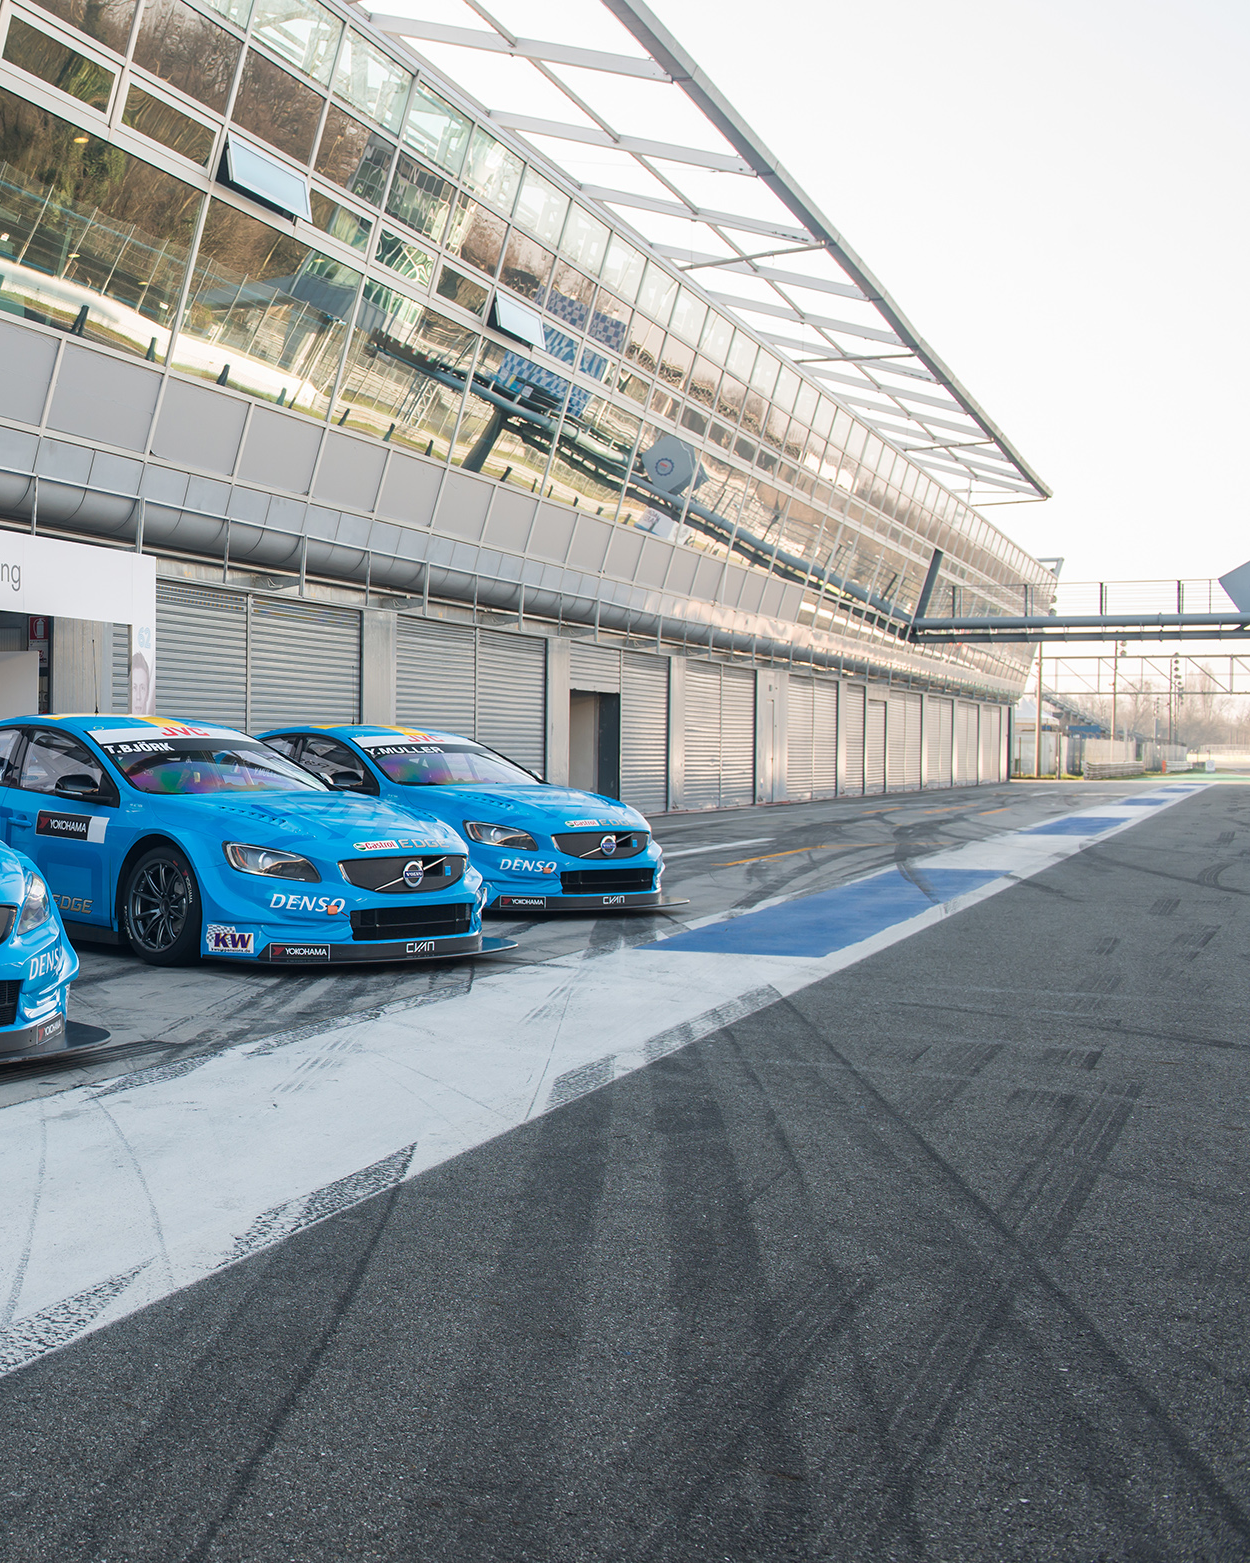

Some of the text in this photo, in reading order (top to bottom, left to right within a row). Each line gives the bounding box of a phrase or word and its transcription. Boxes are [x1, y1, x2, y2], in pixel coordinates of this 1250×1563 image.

[137, 626, 152, 649] 62
[161, 726, 210, 737] JVC
[408, 735, 445, 743] JVC
[104, 741, 175, 755] T.BJÖRK
[364, 746, 445, 756] Y.MULLER
[50, 819, 87, 833] YOKOHAMA
[365, 839, 450, 850] Castrol EDGE
[499, 858, 557, 873] DENSO
[269, 893, 346, 913] DENSO
[511, 898, 544, 906] YOKOHAMA
[213, 932, 252, 949] KW
[285, 947, 327, 956] YOKOHAMA
[29, 947, 62, 981] DENS
